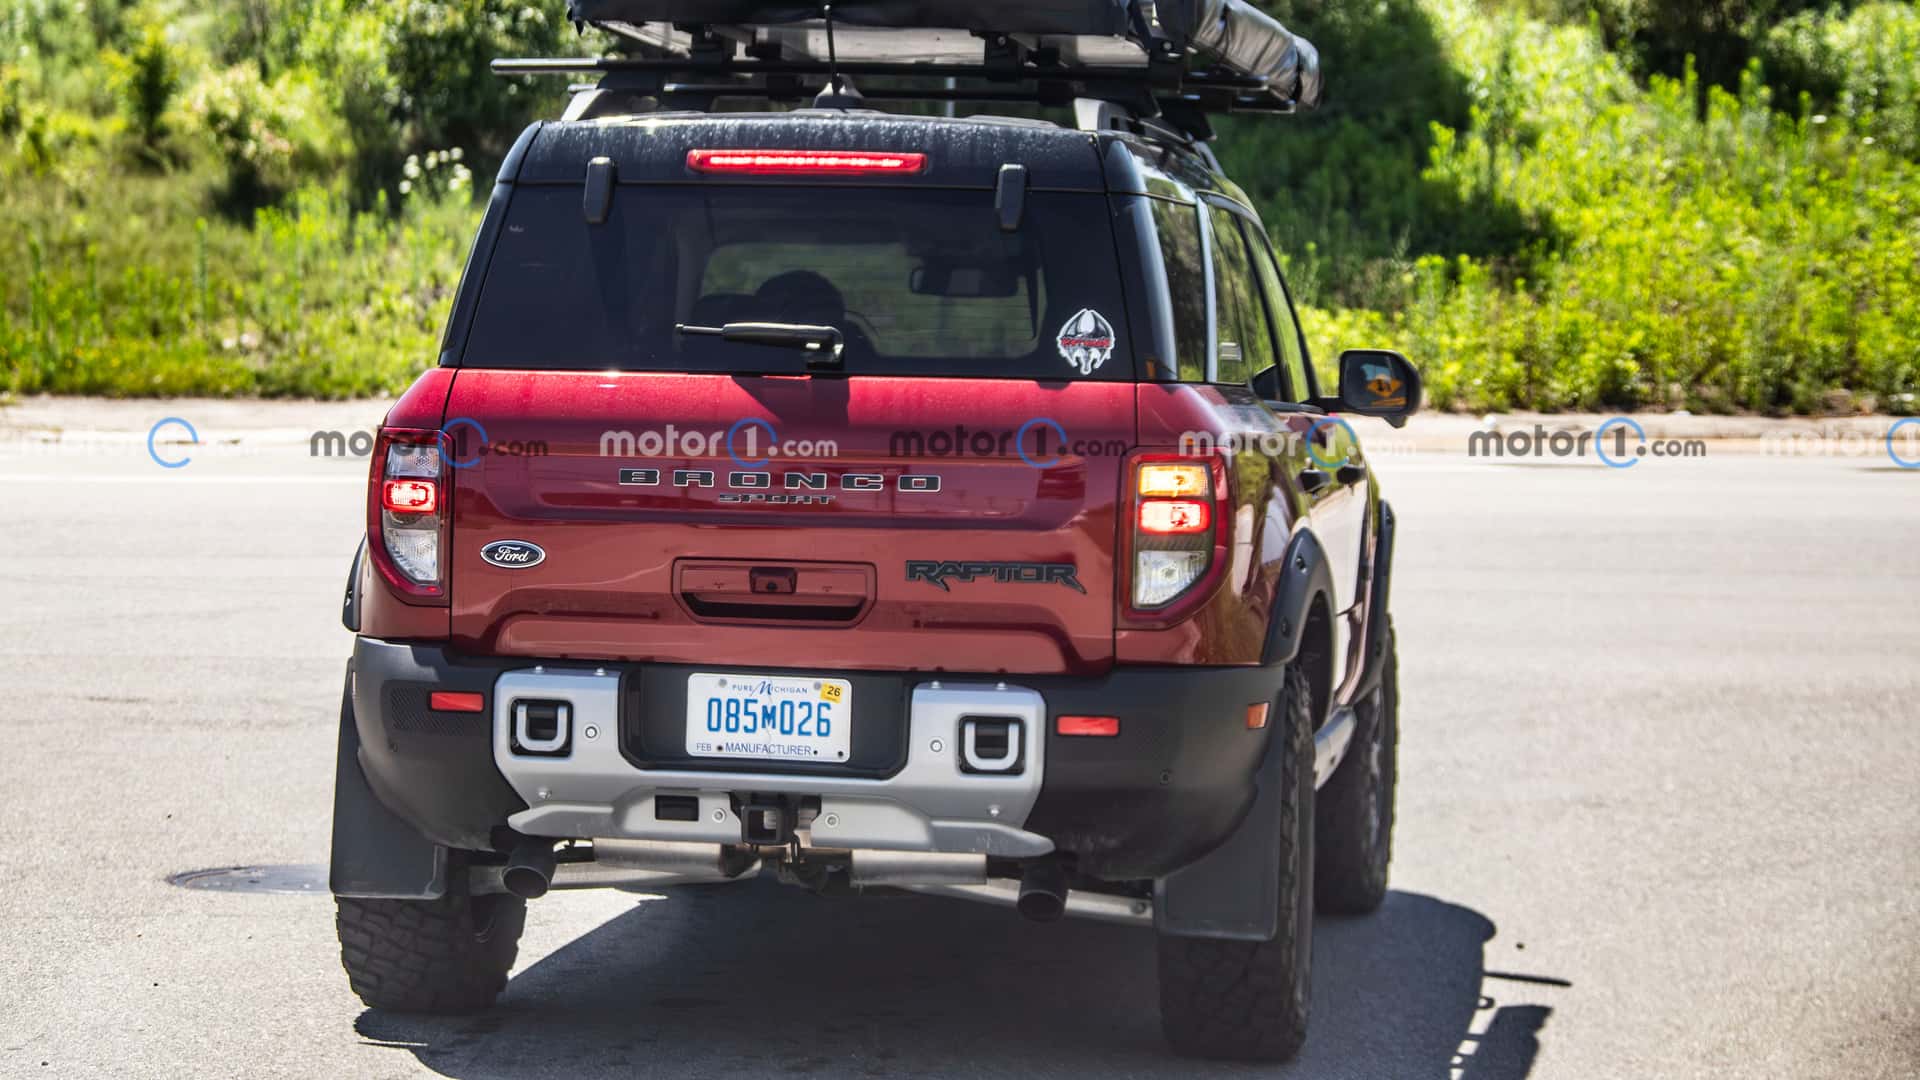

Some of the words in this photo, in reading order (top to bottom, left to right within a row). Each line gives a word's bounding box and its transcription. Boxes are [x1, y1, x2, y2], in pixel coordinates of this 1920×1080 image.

[618, 468, 942, 492] BRONCO
[719, 493, 836, 504] SPORT
[494, 545, 530, 562] Ford
[905, 560, 1087, 595] RAPTOR
[732, 684, 752, 692] PURE
[751, 680, 808, 696] MICHIGAN
[826, 685, 841, 697] 26
[707, 698, 831, 737] 085M026
[696, 743, 712, 752] FEB
[725, 742, 812, 756] MANUFACTURER
